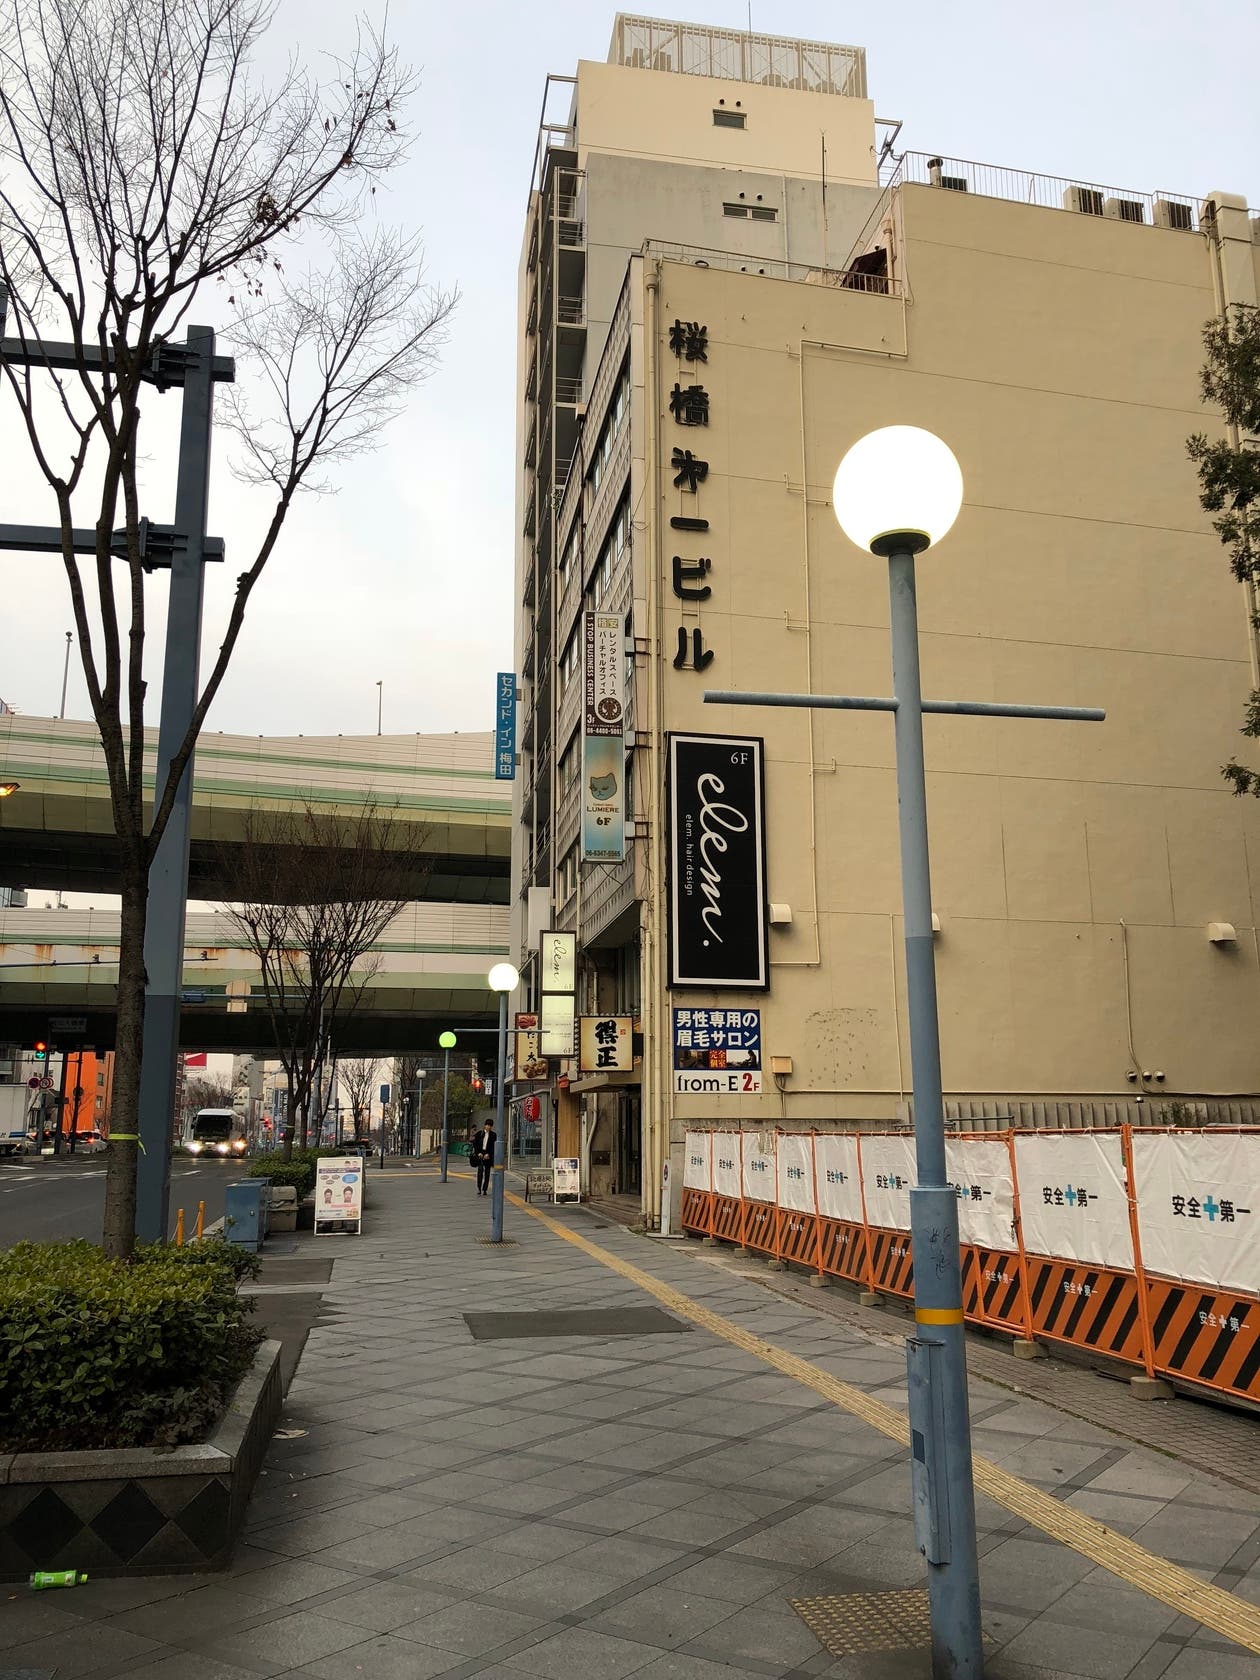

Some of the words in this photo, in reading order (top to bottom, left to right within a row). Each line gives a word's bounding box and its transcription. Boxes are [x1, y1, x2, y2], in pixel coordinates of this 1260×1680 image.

[599, 631, 607, 695] バーチャルオフィス
[730, 752, 748, 765] 6F
[596, 817, 611, 826] 6F
[686, 814, 694, 840] elem.
[686, 843, 694, 862] hair
[697, 773, 749, 947] elem.
[684, 864, 694, 896] design
[553, 939, 567, 984] elem.
[677, 1011, 758, 1028] 男性専用の
[677, 1030, 758, 1047] 眉毛サロン
[563, 1047, 573, 1055] 6F
[677, 1075, 738, 1091] from-E
[742, 1072, 760, 1092] 2F
[1042, 1186, 1098, 1208] 安全第一
[1172, 1195, 1251, 1223] 安全第一
